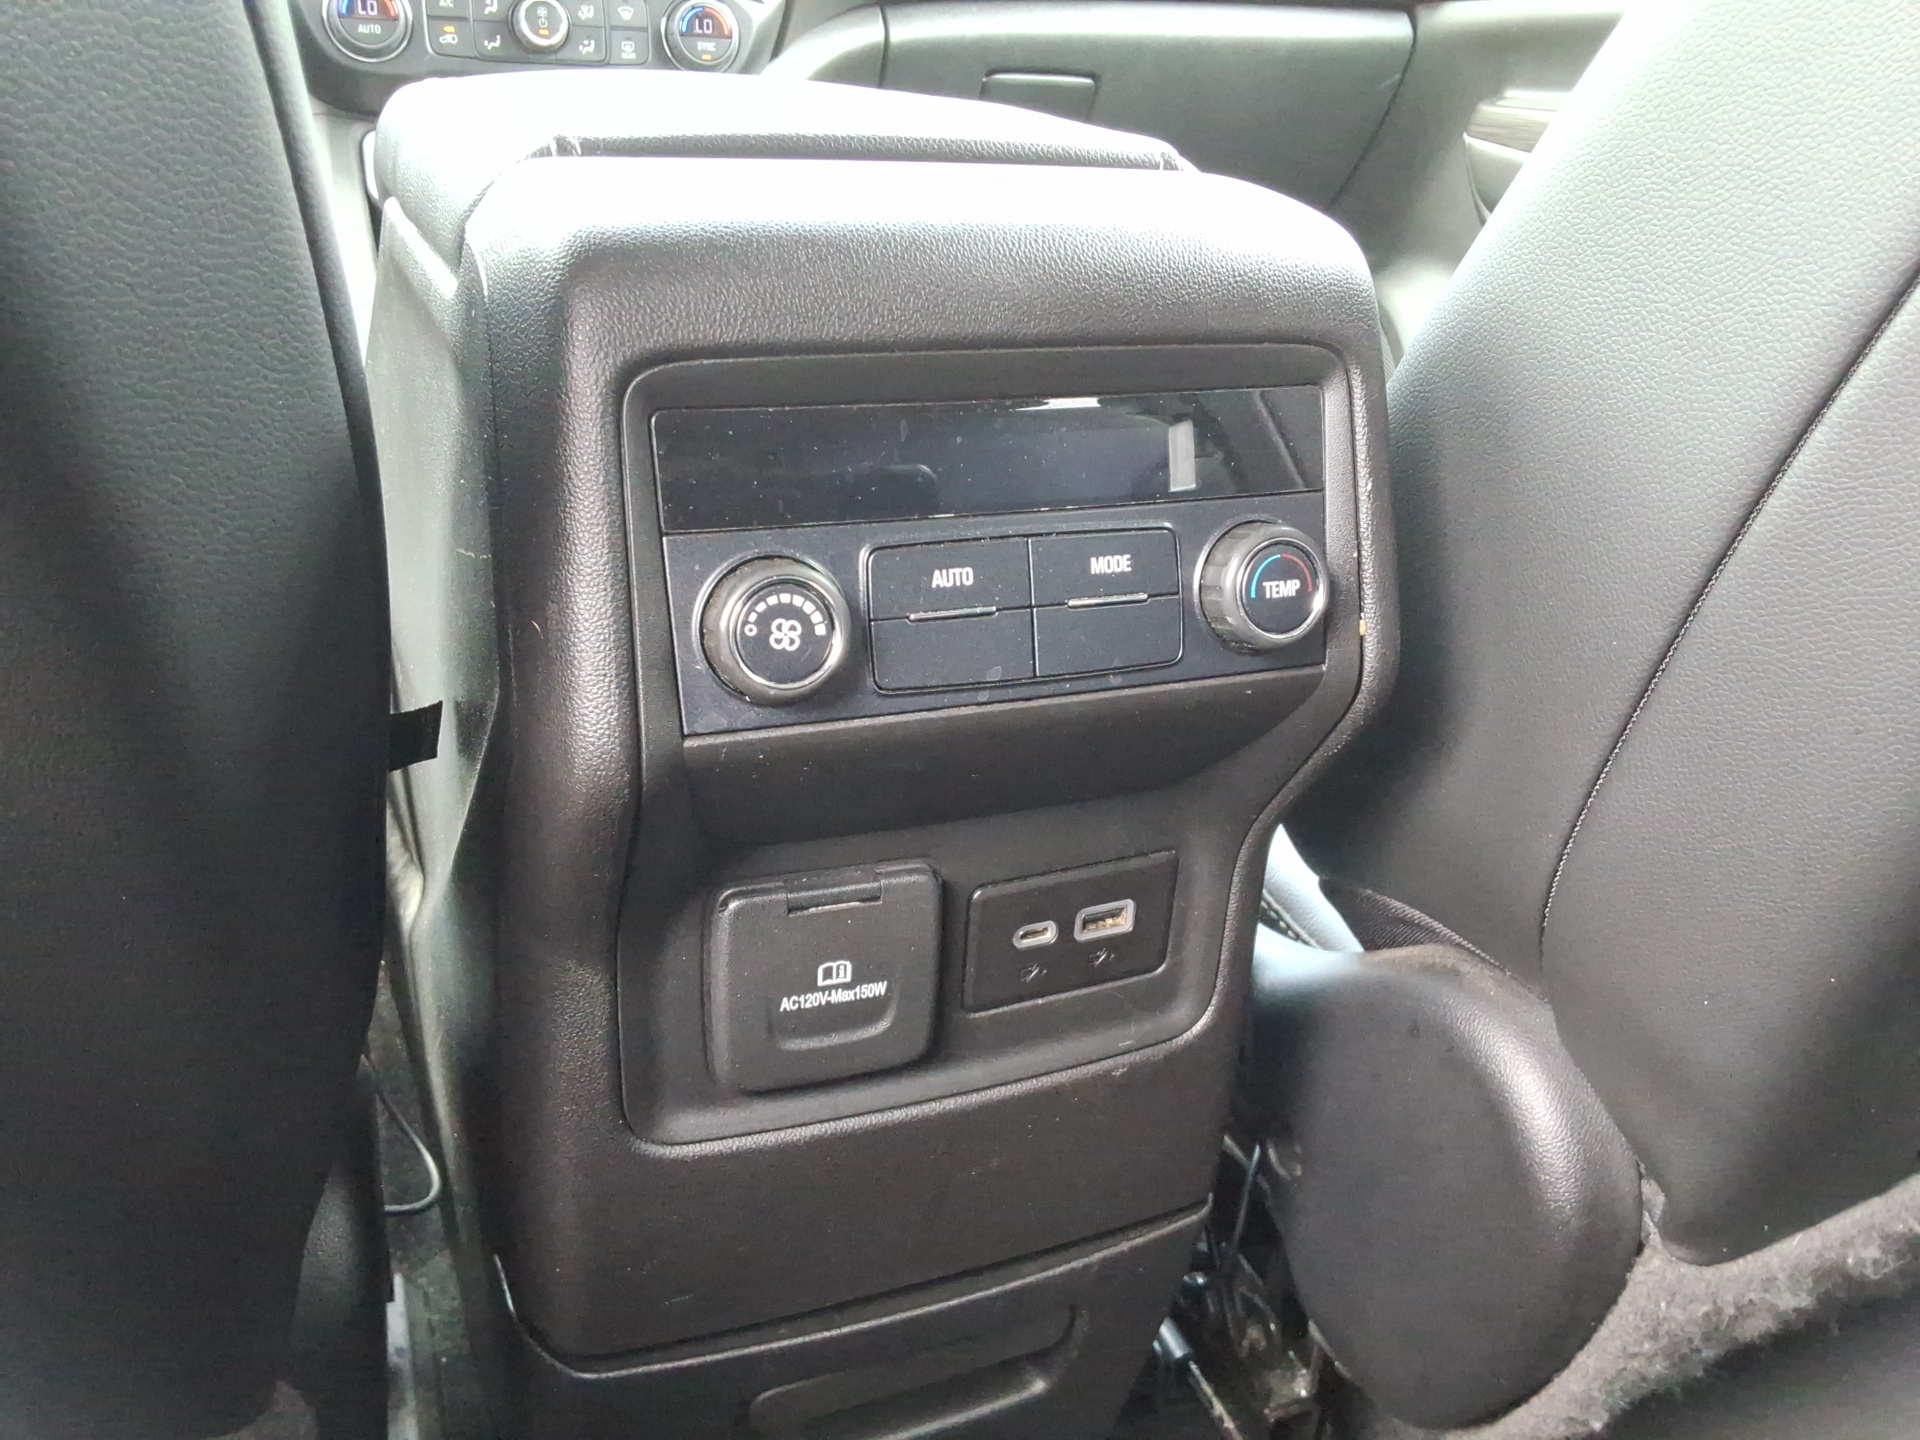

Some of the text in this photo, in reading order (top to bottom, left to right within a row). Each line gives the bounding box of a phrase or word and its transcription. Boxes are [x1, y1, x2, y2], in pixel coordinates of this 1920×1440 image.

[358, 0, 378, 15] LO
[357, 24, 381, 34] AUTO
[695, 18, 713, 33] LO
[1090, 554, 1132, 575] MODE
[932, 567, 974, 588] AUTO
[1262, 579, 1301, 599] TEMP
[780, 980, 888, 1012] AC120V-Max150W
